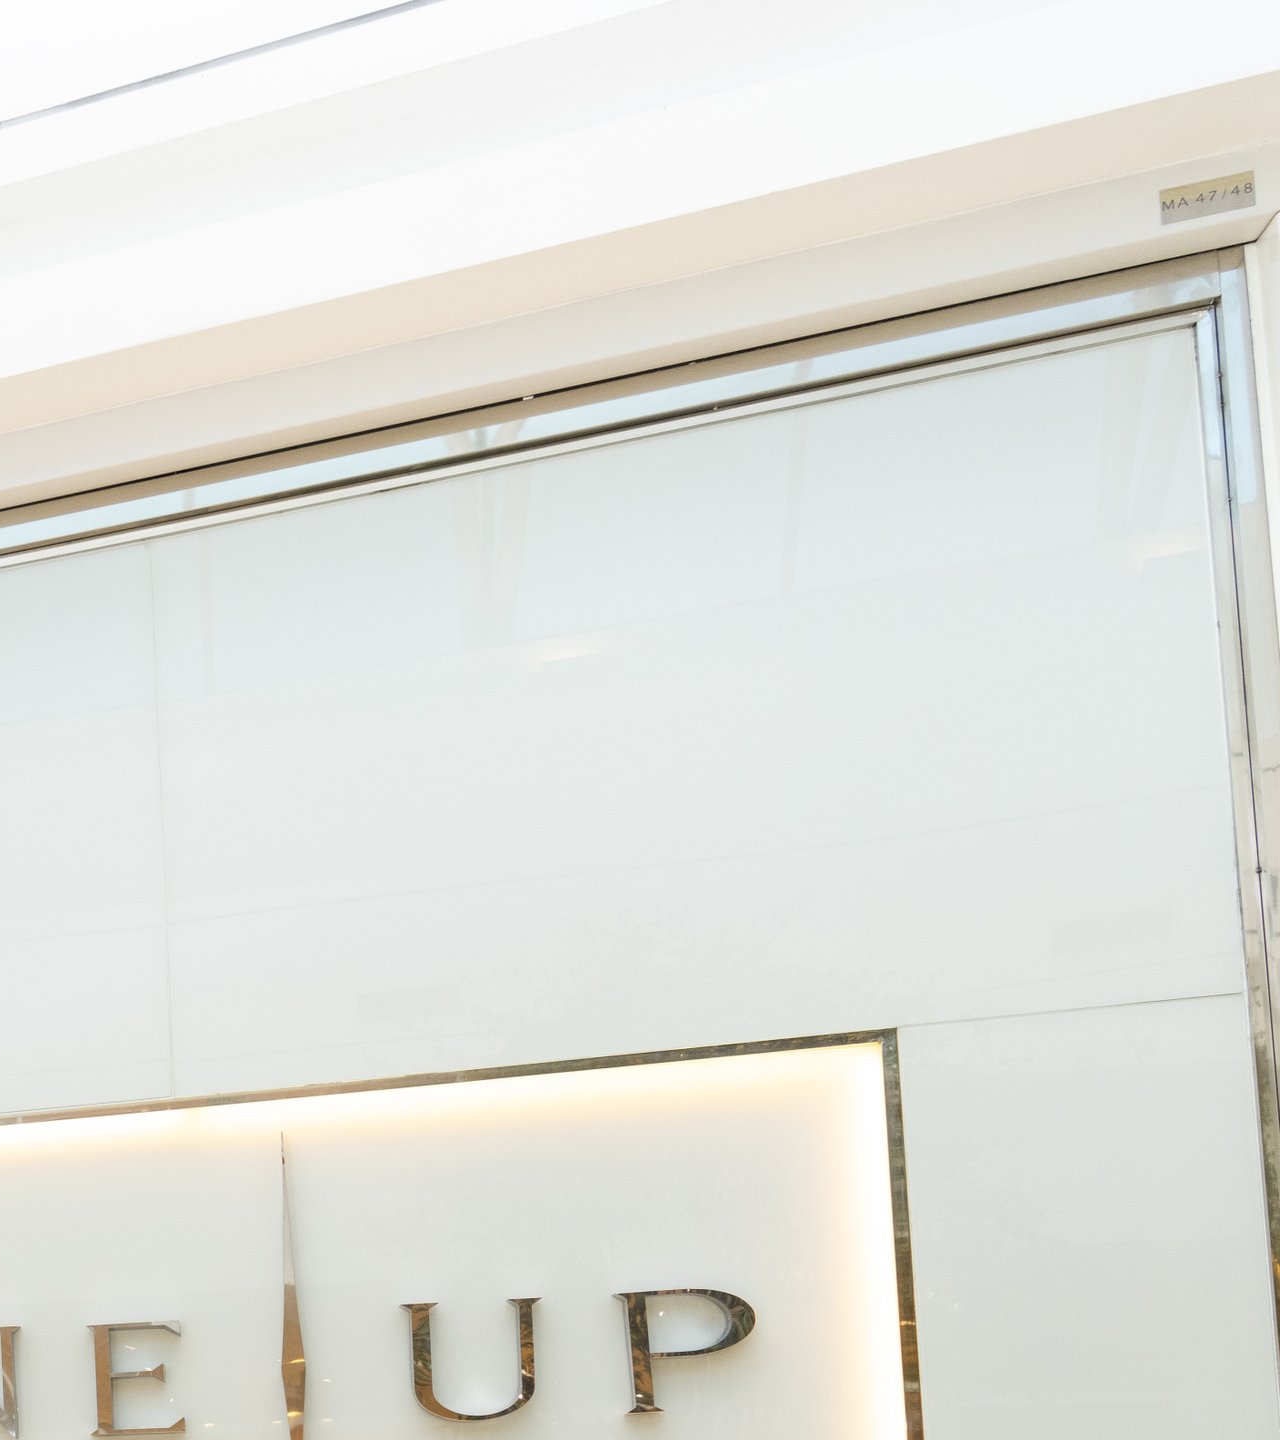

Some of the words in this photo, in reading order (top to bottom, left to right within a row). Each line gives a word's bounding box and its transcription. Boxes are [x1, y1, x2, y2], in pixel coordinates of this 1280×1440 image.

[1161, 197, 1189, 212] MA
[1195, 182, 1253, 203] 47/48
[398, 1287, 757, 1424] UP
